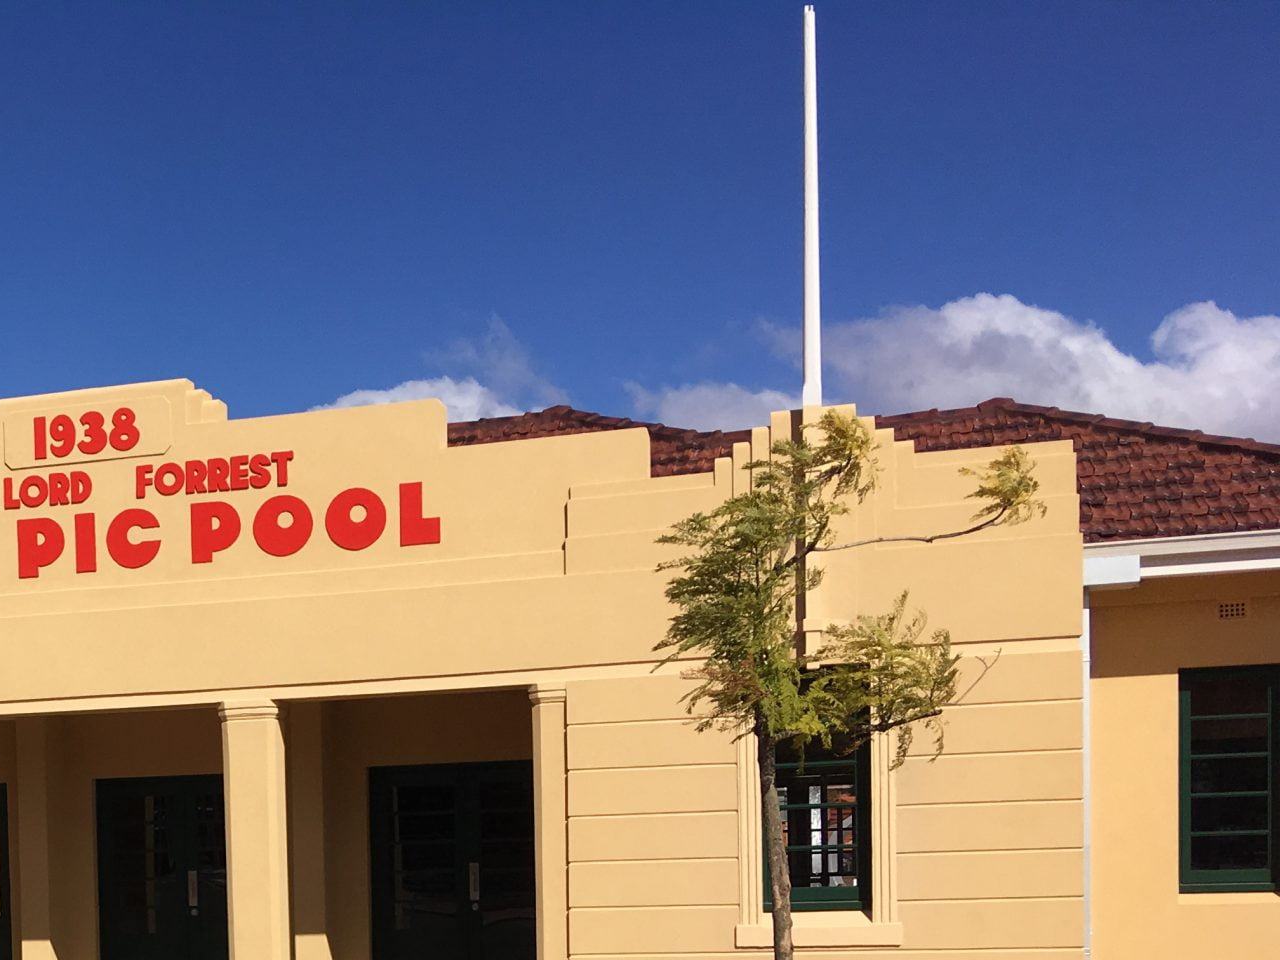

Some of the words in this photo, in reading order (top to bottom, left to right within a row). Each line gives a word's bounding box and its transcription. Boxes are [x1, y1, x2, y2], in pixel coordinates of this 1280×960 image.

[32, 406, 141, 460] 1938
[3, 470, 93, 511] LORD
[135, 450, 295, 500] FORREST
[190, 480, 442, 565] POOL
